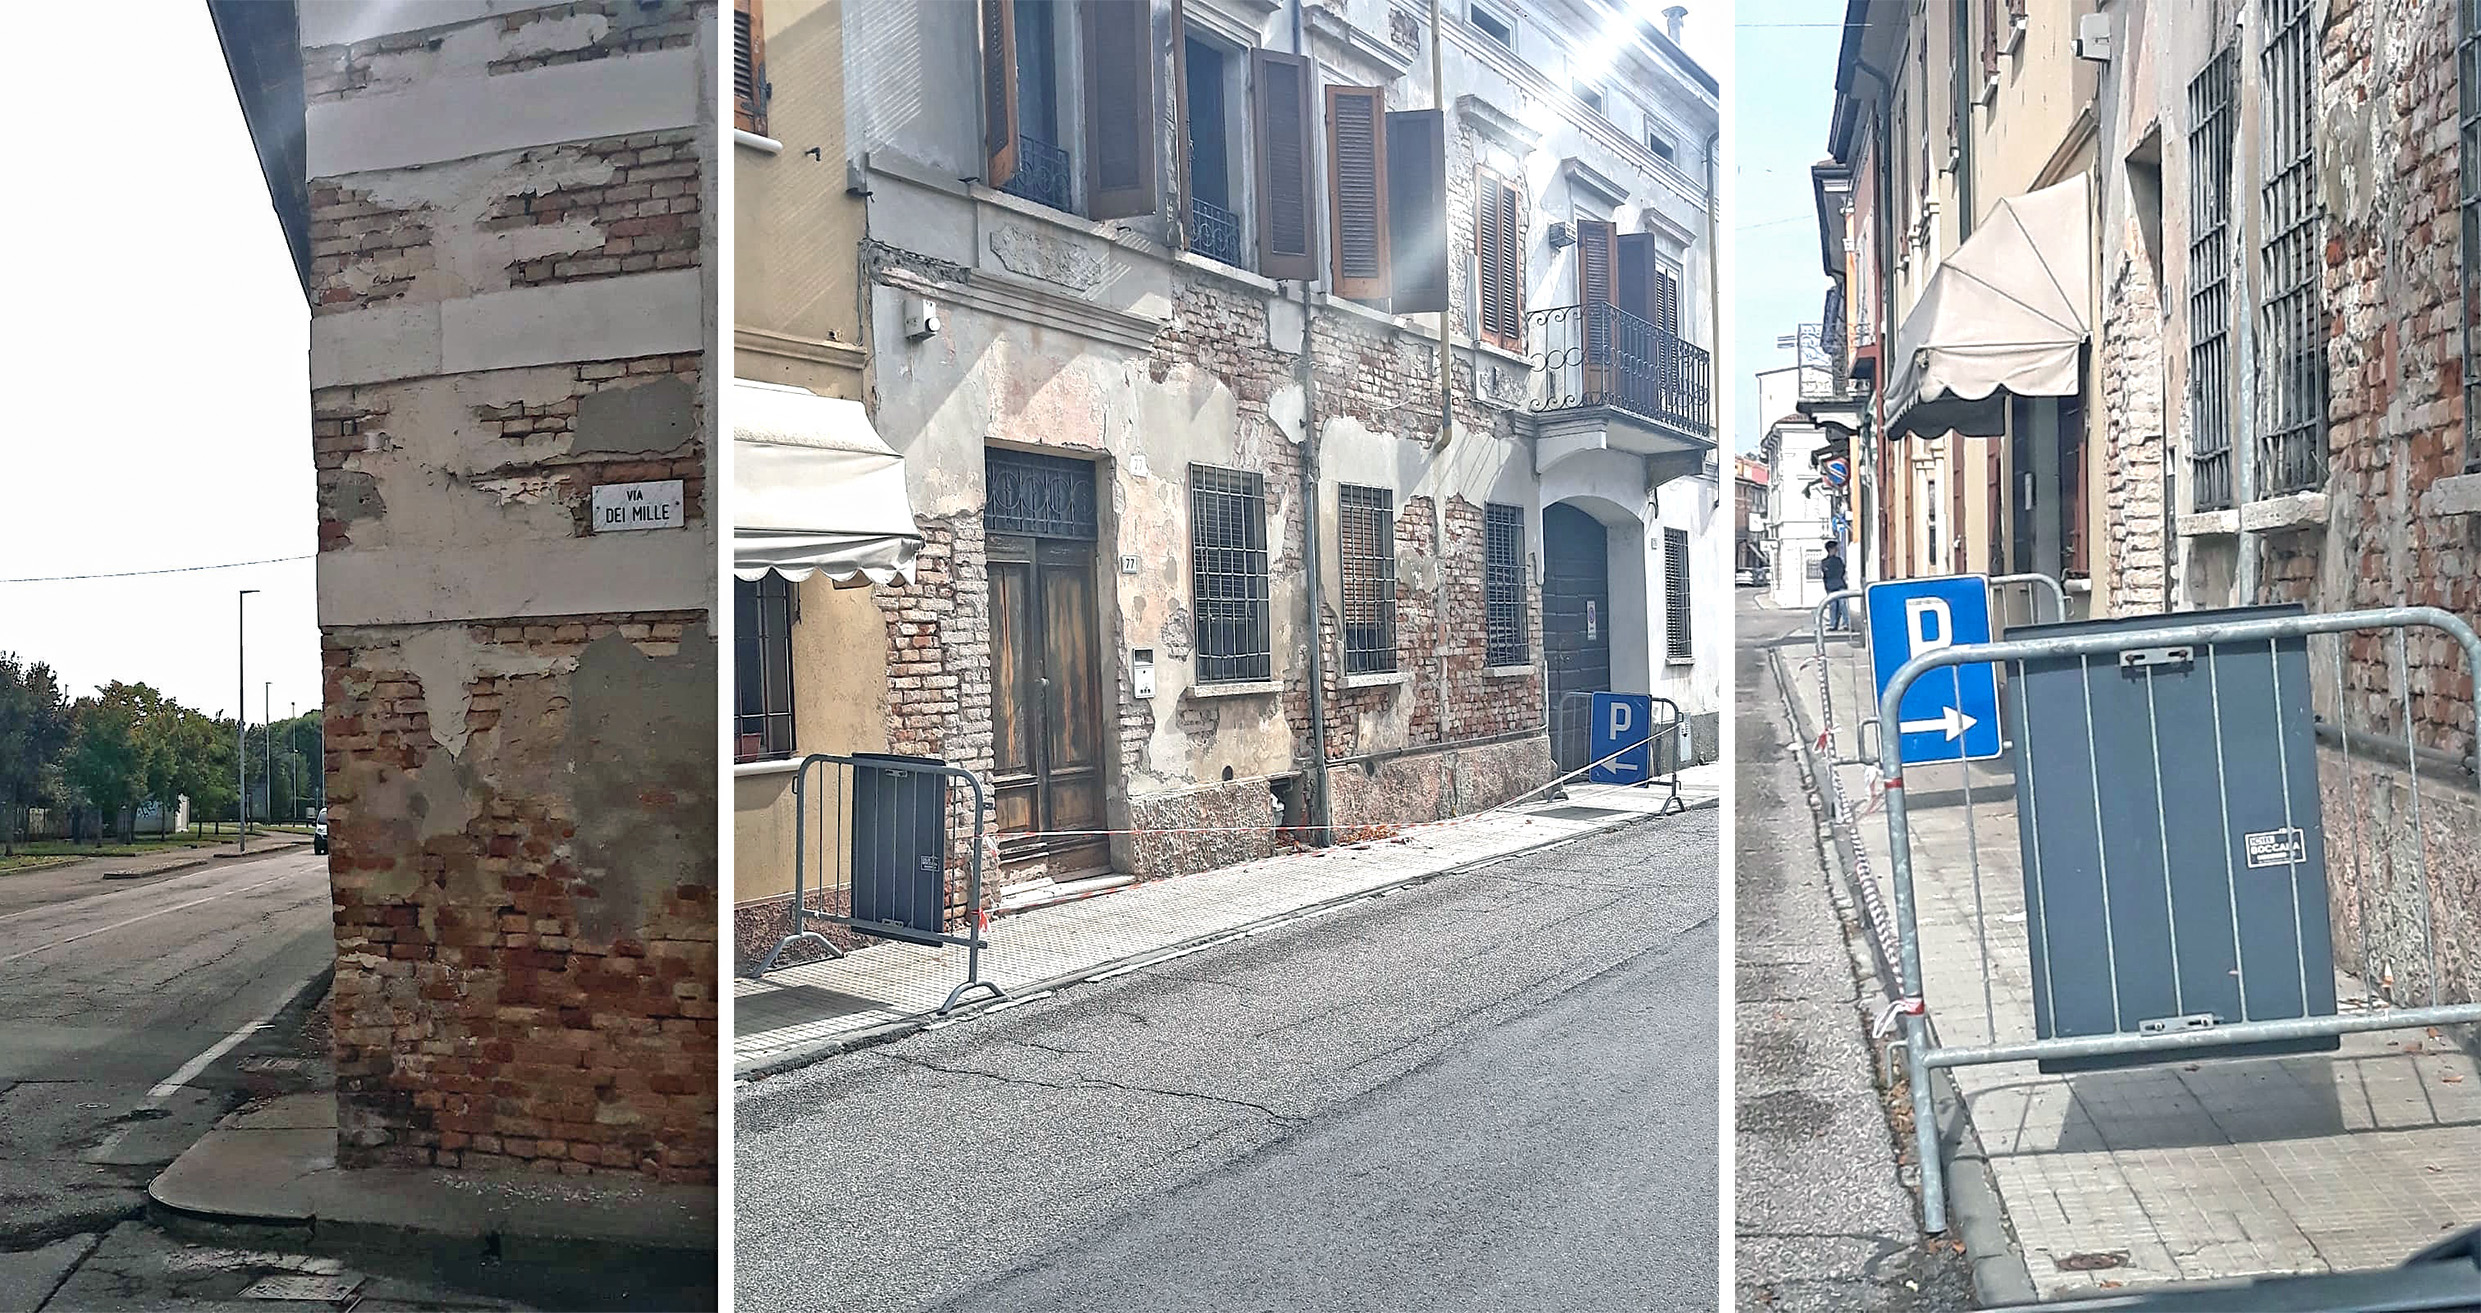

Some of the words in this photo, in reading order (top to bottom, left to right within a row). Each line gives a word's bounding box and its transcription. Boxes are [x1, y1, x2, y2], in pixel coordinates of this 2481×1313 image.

[626, 490, 643, 501] VIA
[606, 507, 626, 523] DEI
[632, 504, 670, 522] MILLE
[1125, 558, 1135, 569] 77
[1905, 596, 1953, 660] P
[1609, 702, 1632, 740] P
